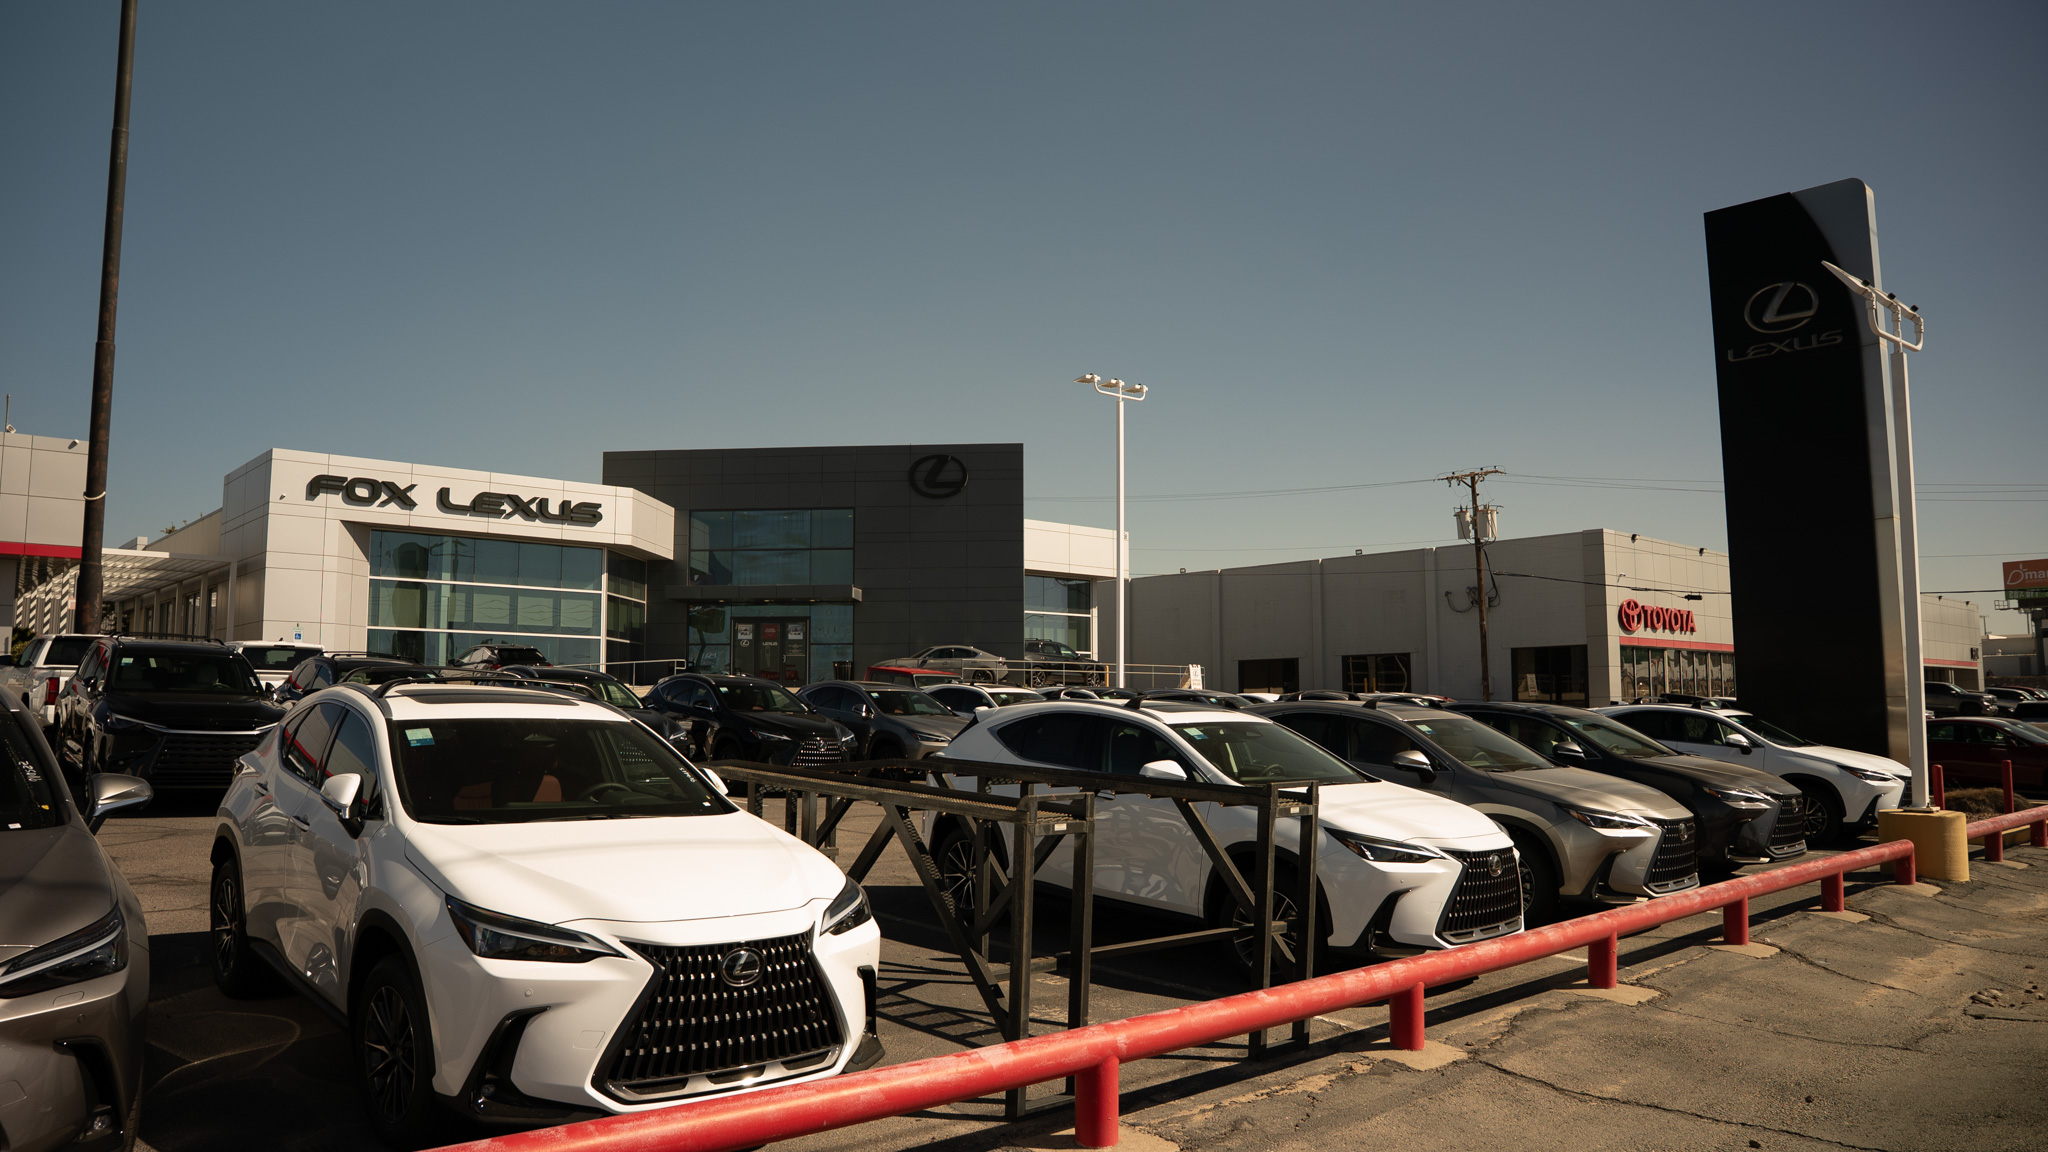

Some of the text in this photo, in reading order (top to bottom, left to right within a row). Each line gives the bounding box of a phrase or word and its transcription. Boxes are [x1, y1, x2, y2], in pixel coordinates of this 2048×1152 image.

[1727, 329, 1844, 362] LEXUS
[306, 474, 603, 525] FOX LEXUS
[1642, 605, 1697, 633] TOYOTA
